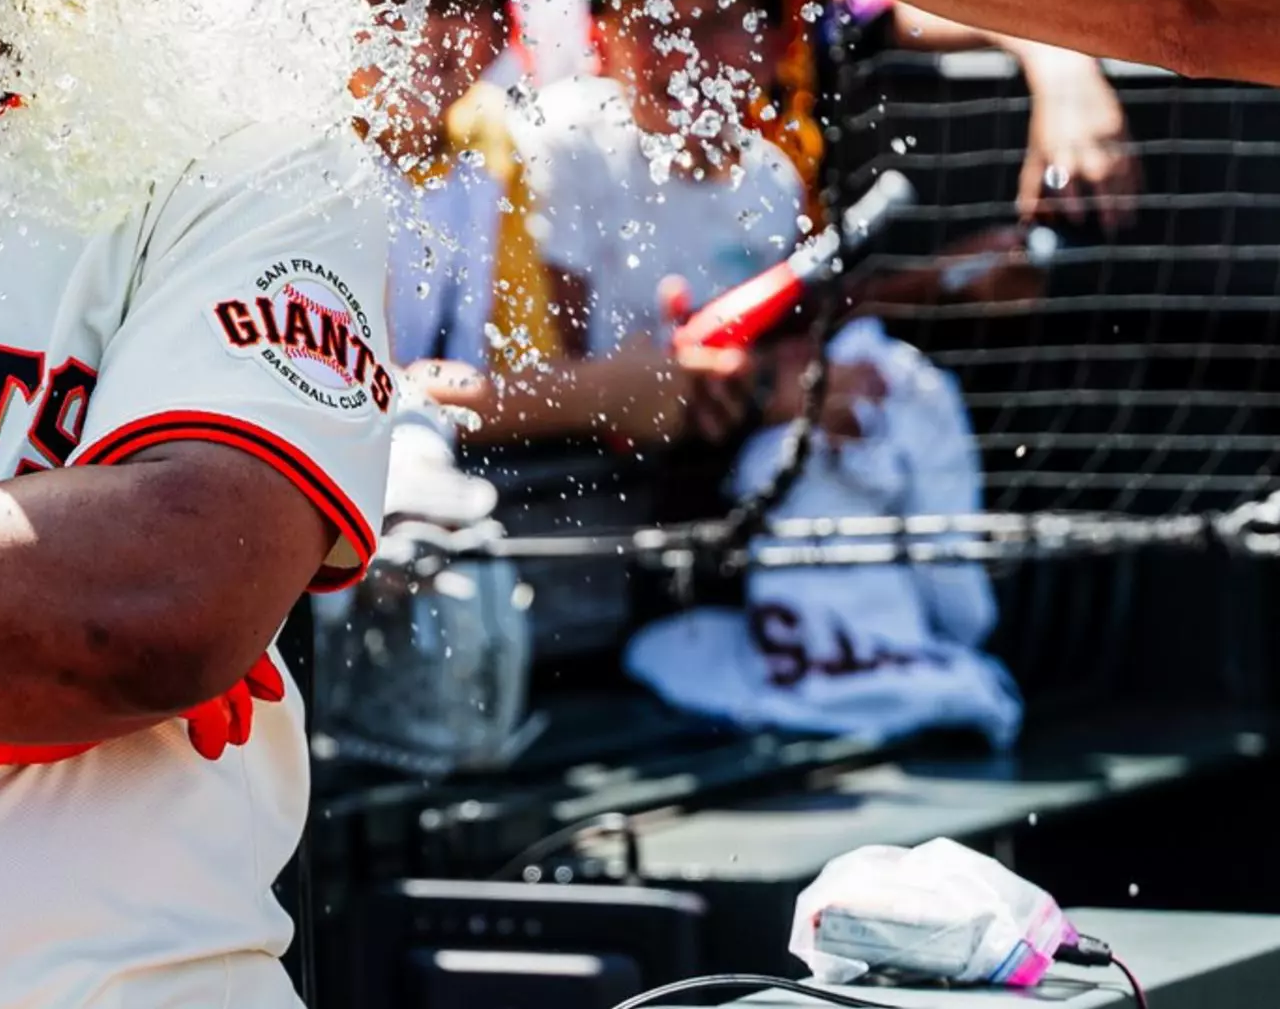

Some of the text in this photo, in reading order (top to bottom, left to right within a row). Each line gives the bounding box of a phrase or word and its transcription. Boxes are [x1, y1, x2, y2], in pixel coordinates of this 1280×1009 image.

[256, 258, 372, 339] SAN FRANCISCO
[214, 296, 394, 413] GIANTS
[261, 348, 368, 410] BASEBALL CLUB
